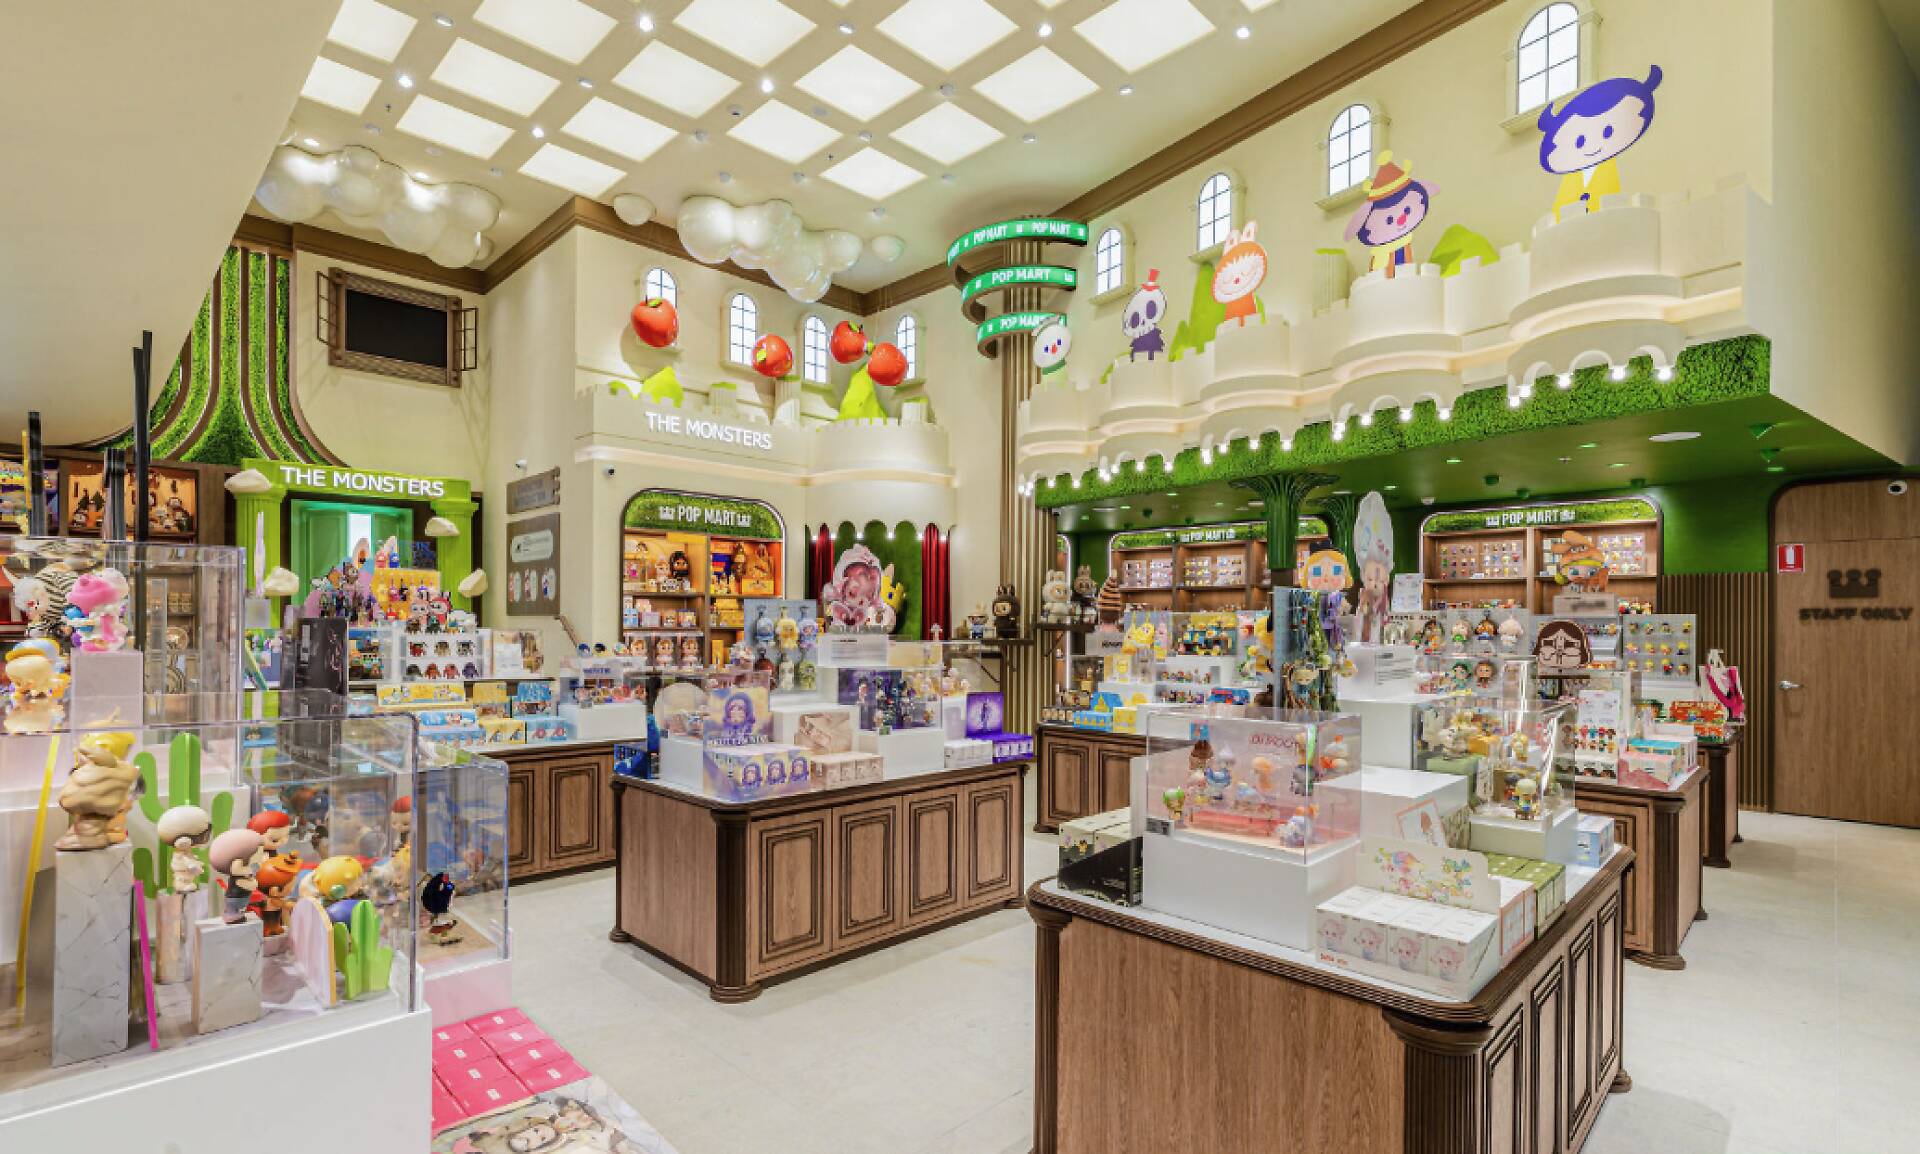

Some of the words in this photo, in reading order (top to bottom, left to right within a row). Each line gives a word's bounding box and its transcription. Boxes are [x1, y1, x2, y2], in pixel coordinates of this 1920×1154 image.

[1031, 222, 1048, 233] POP
[1049, 223, 1071, 235] MART
[992, 270, 1013, 284] POP
[1015, 268, 1051, 281] MART
[1000, 317, 1017, 329] POP
[645, 411, 681, 433] THE
[686, 419, 772, 450] MONSTERS
[279, 465, 327, 487] THE
[333, 471, 444, 496] MONSTERS
[678, 504, 701, 522] POP
[704, 508, 737, 526] MART
[1502, 511, 1524, 526] POP
[1526, 509, 1559, 524] MART
[1799, 607, 1857, 621] STAFF
[1861, 606, 1913, 621] ONLY
